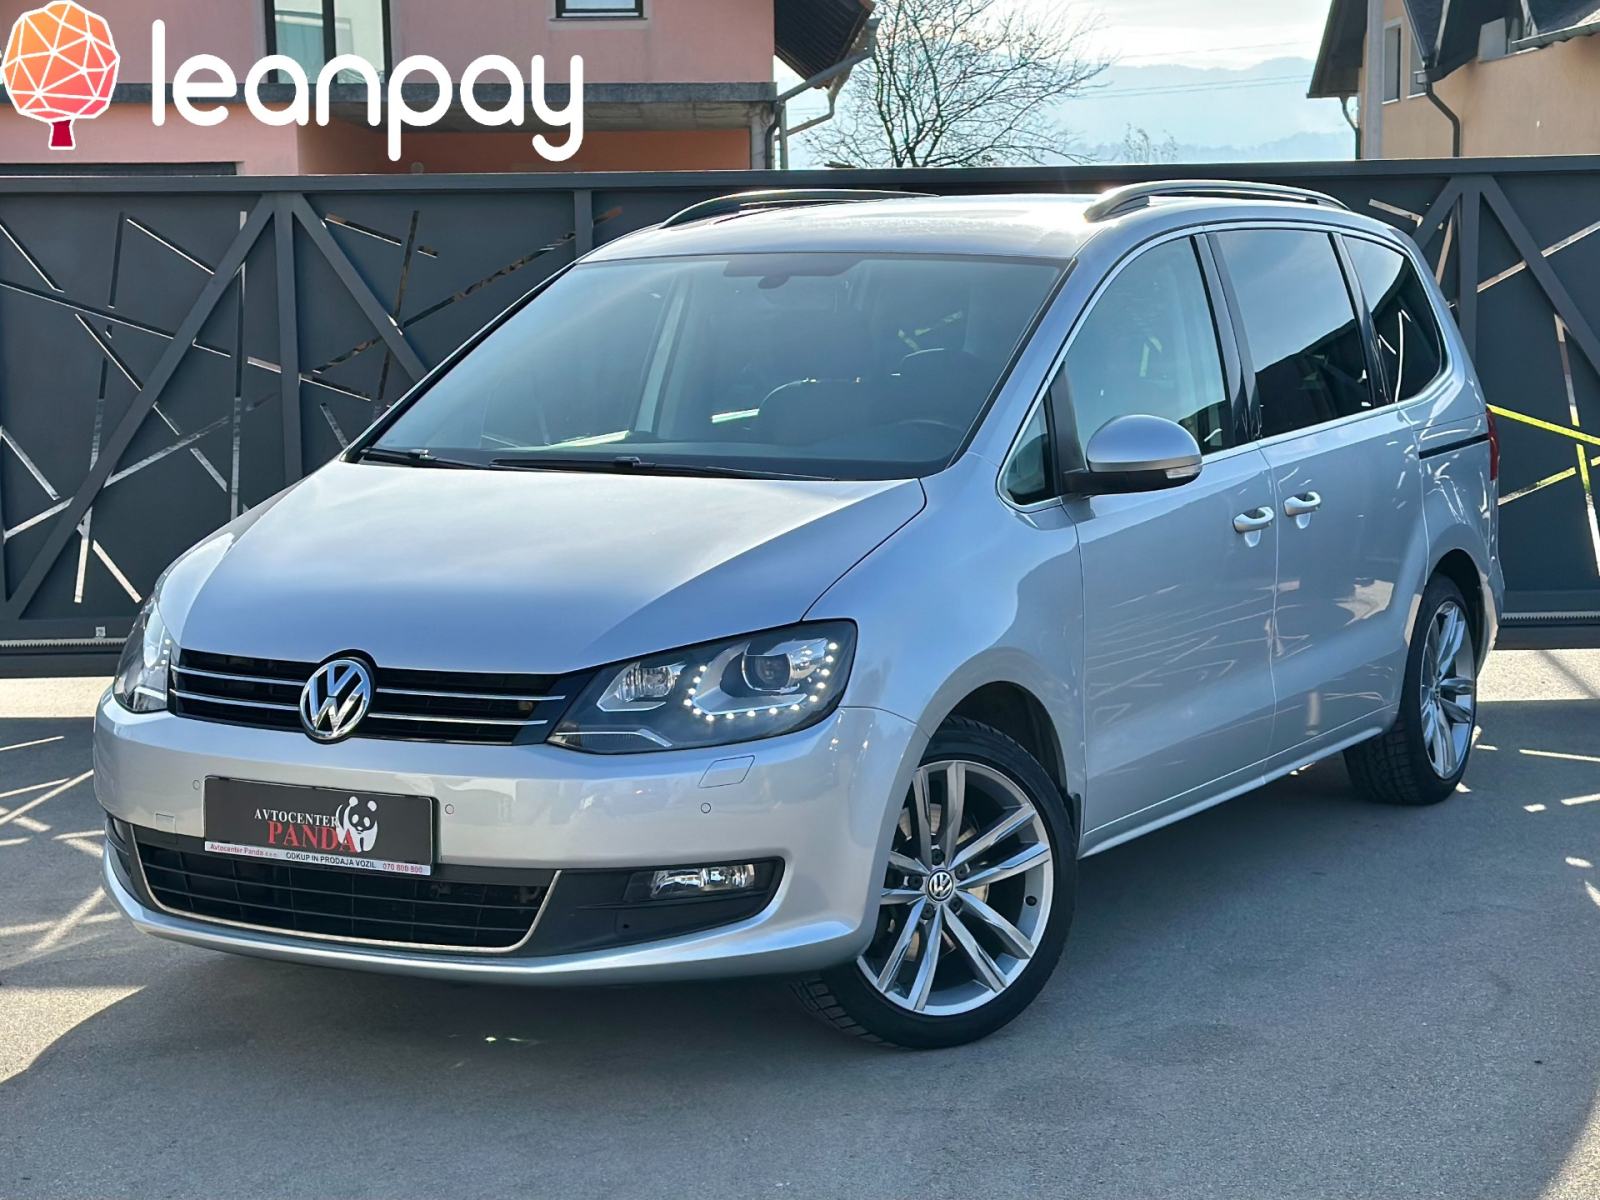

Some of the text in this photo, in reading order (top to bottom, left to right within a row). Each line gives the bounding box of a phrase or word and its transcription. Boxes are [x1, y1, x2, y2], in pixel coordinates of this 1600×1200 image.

[300, 659, 371, 737] VW
[254, 808, 339, 828] AVTOCENTER
[267, 820, 357, 853] PANDA
[286, 851, 310, 862] ODKUP
[320, 856, 355, 867] PRODAJA
[355, 860, 376, 869] VOZIL
[929, 871, 953, 900] VW
